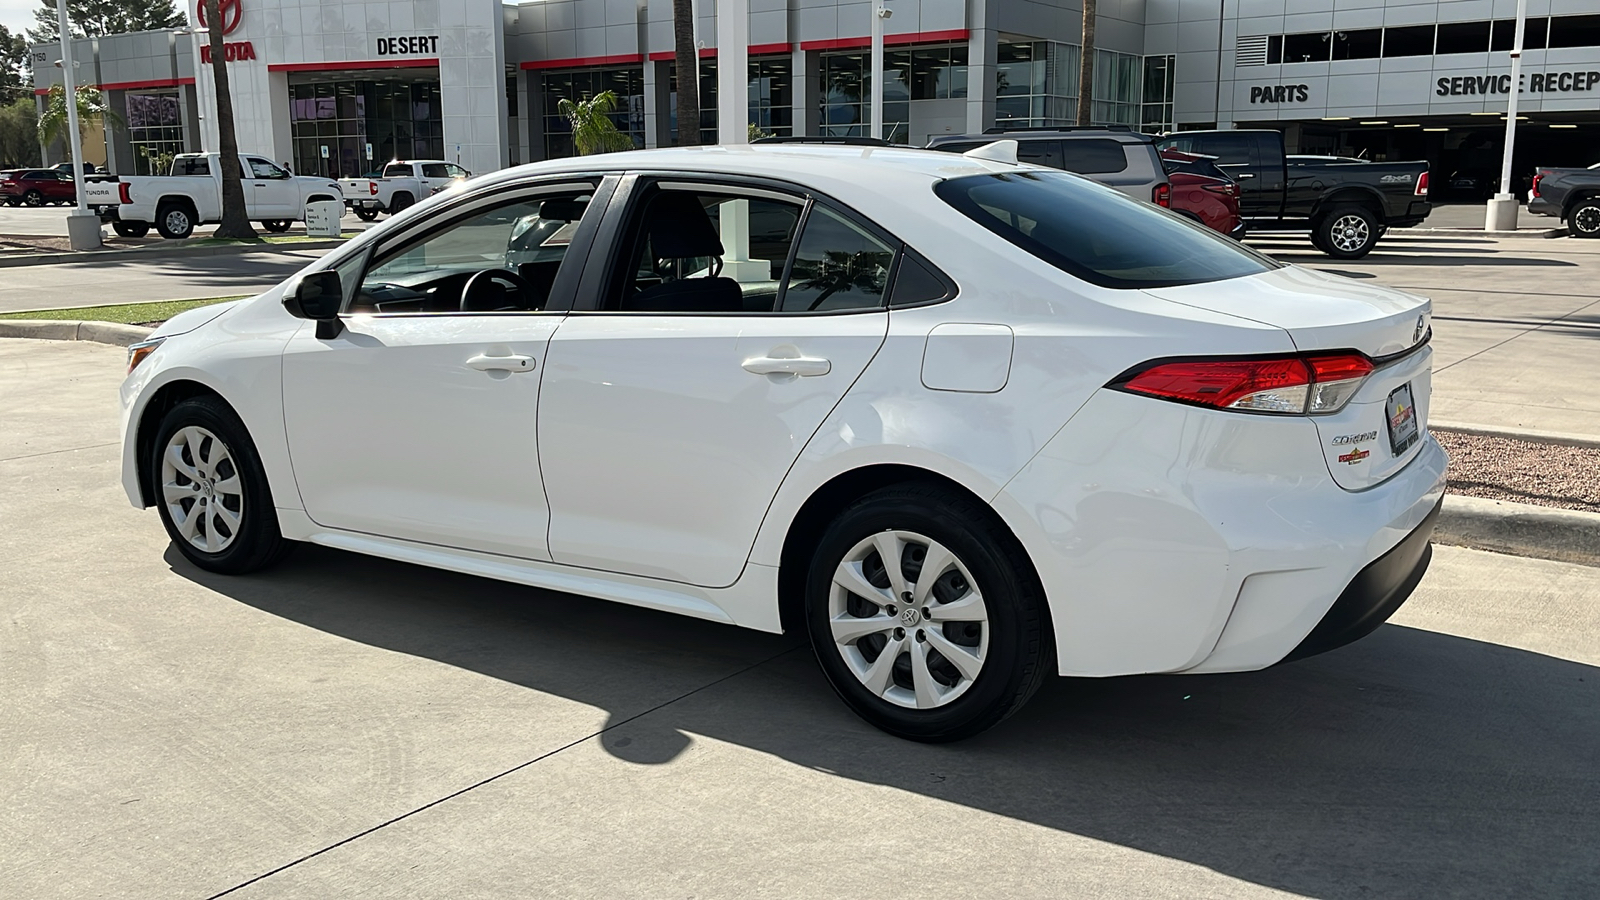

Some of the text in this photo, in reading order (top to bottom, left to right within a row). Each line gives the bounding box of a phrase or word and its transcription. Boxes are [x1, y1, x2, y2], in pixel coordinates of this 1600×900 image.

[200, 41, 256, 63] TOOTA
[377, 36, 438, 55] DESERT
[1530, 71, 1600, 93] RECEP
[1250, 85, 1309, 103] PARTS
